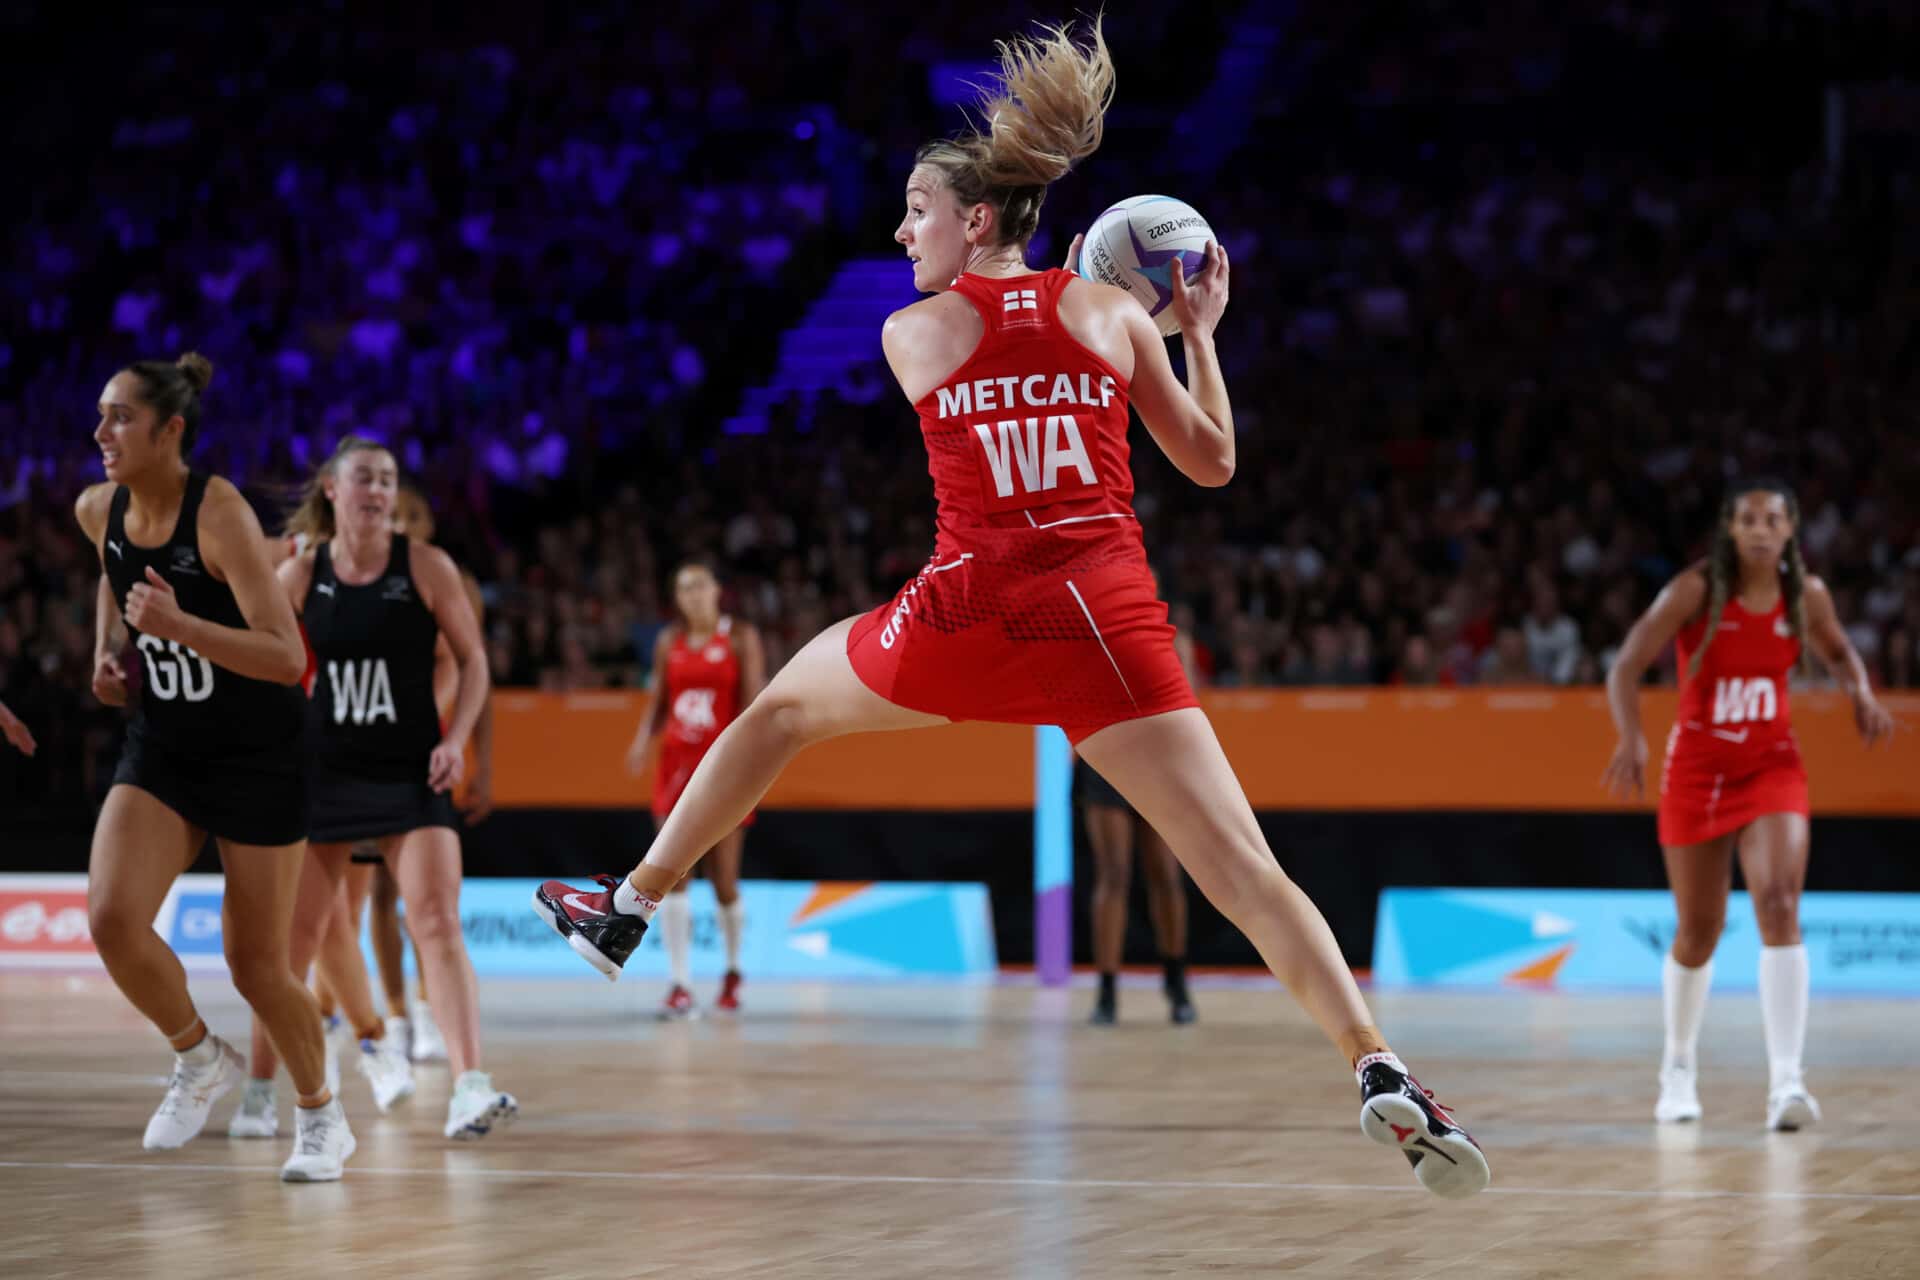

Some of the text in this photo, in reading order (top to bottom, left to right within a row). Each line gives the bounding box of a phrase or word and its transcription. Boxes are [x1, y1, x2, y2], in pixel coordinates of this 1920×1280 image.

[1147, 220, 1177, 240] 2022
[1095, 241, 1132, 291] port is just
[935, 373, 1117, 419] METCALF
[973, 414, 1098, 498] WA
[136, 633, 214, 702] GD
[327, 658, 397, 725] WA
[633, 895, 657, 911] KU
